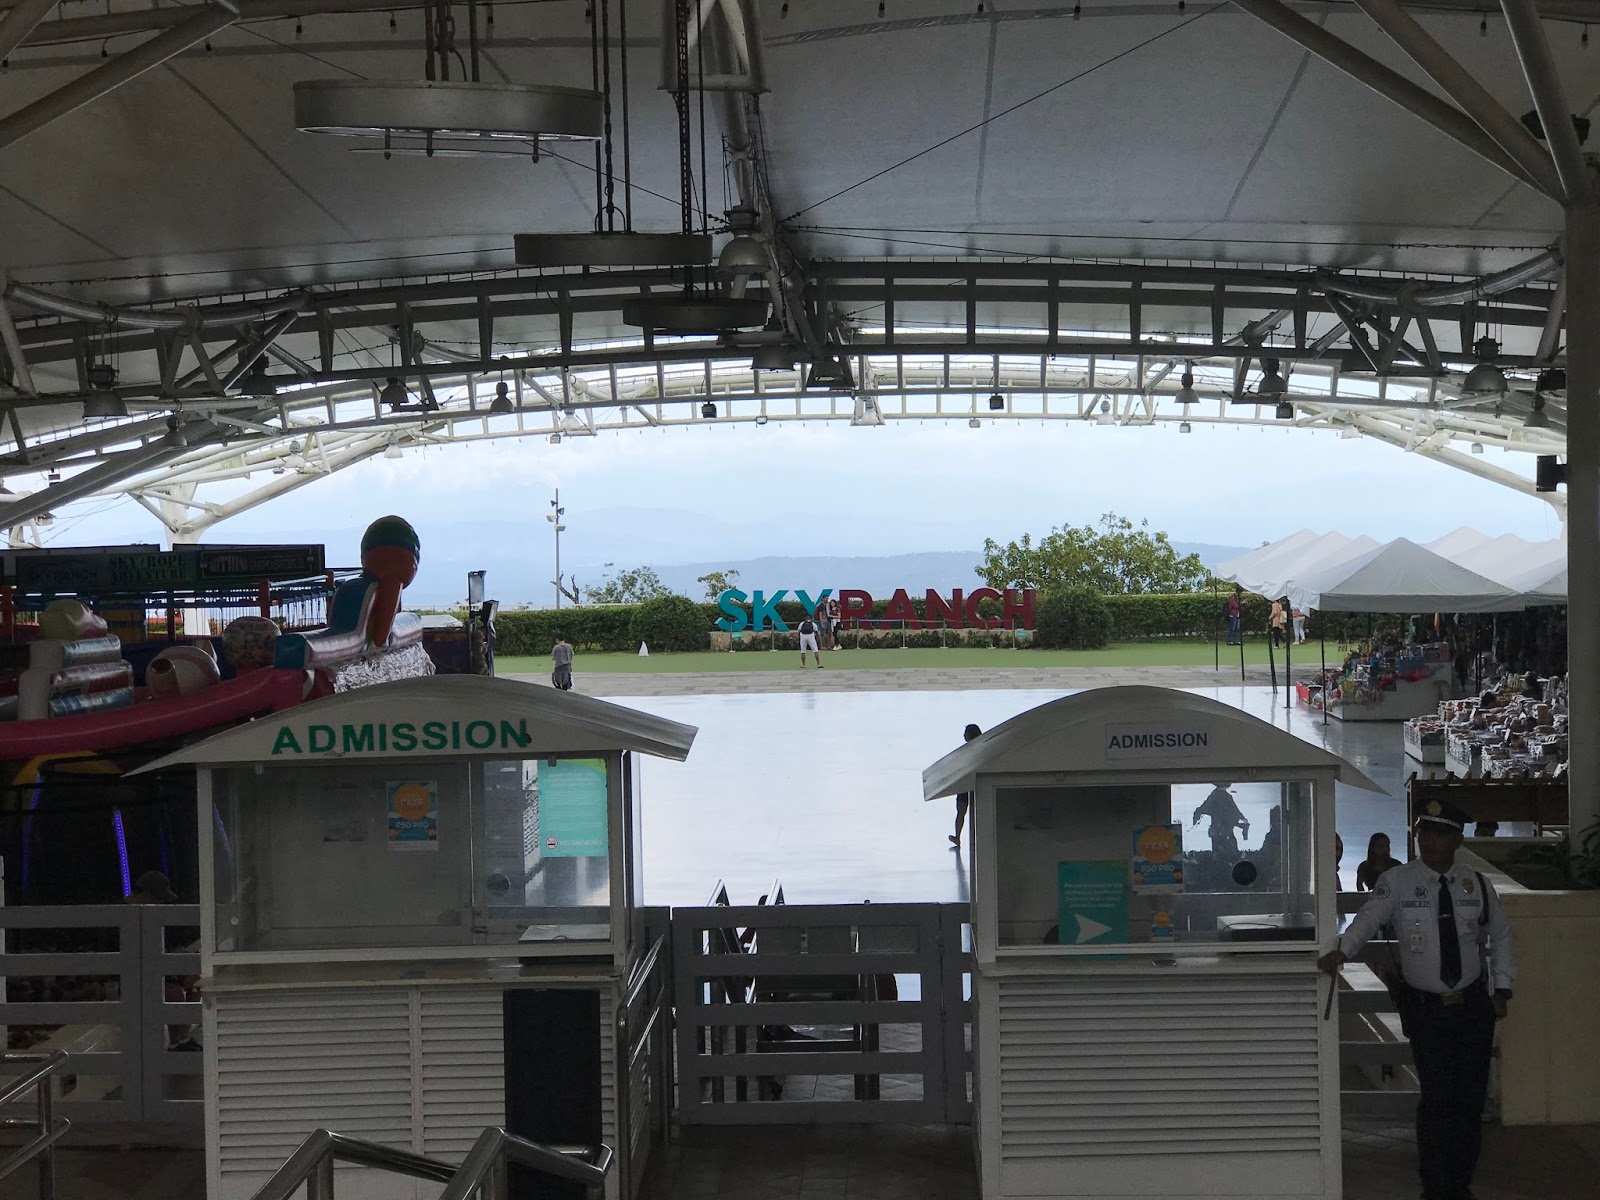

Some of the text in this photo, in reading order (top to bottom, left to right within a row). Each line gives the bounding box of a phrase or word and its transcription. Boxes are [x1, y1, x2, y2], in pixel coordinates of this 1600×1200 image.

[110, 568, 187, 583] ADVENTURE
[272, 719, 529, 754] ADMISSION
[1108, 732, 1207, 749] ADMISSION
